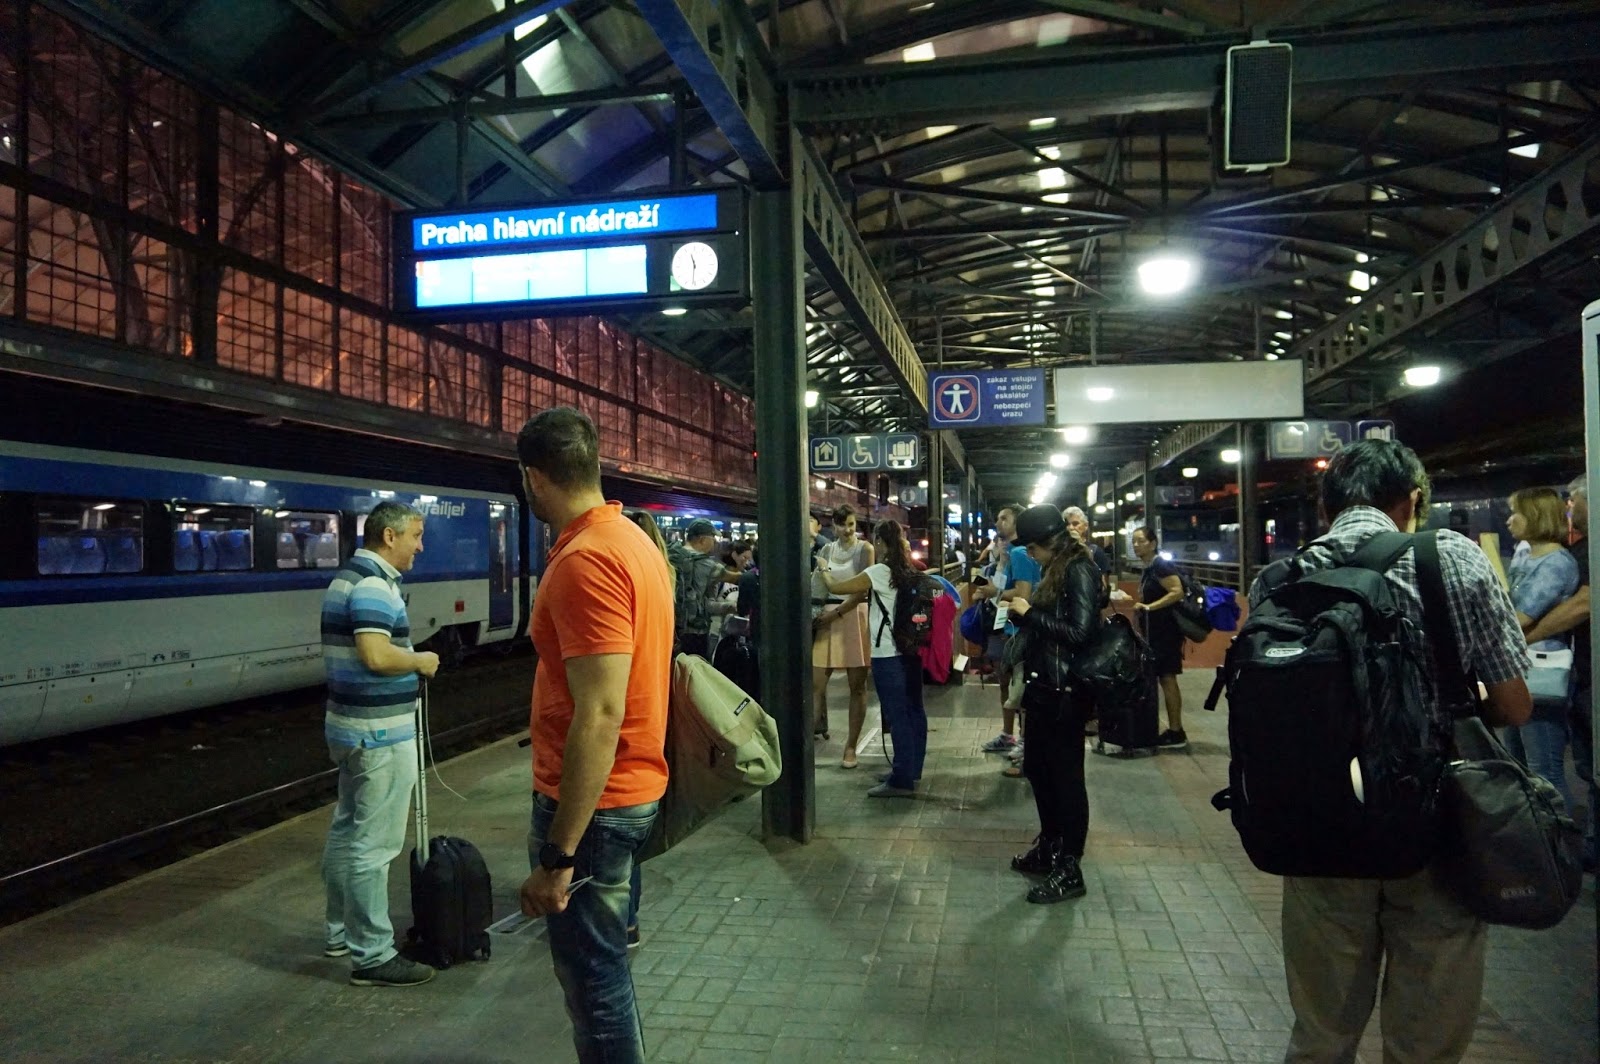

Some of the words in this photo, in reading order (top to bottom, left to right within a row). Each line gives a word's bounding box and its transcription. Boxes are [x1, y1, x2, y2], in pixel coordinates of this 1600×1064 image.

[421, 221, 488, 246] Praha
[493, 212, 565, 240] hlavní
[570, 204, 660, 234] nádraží
